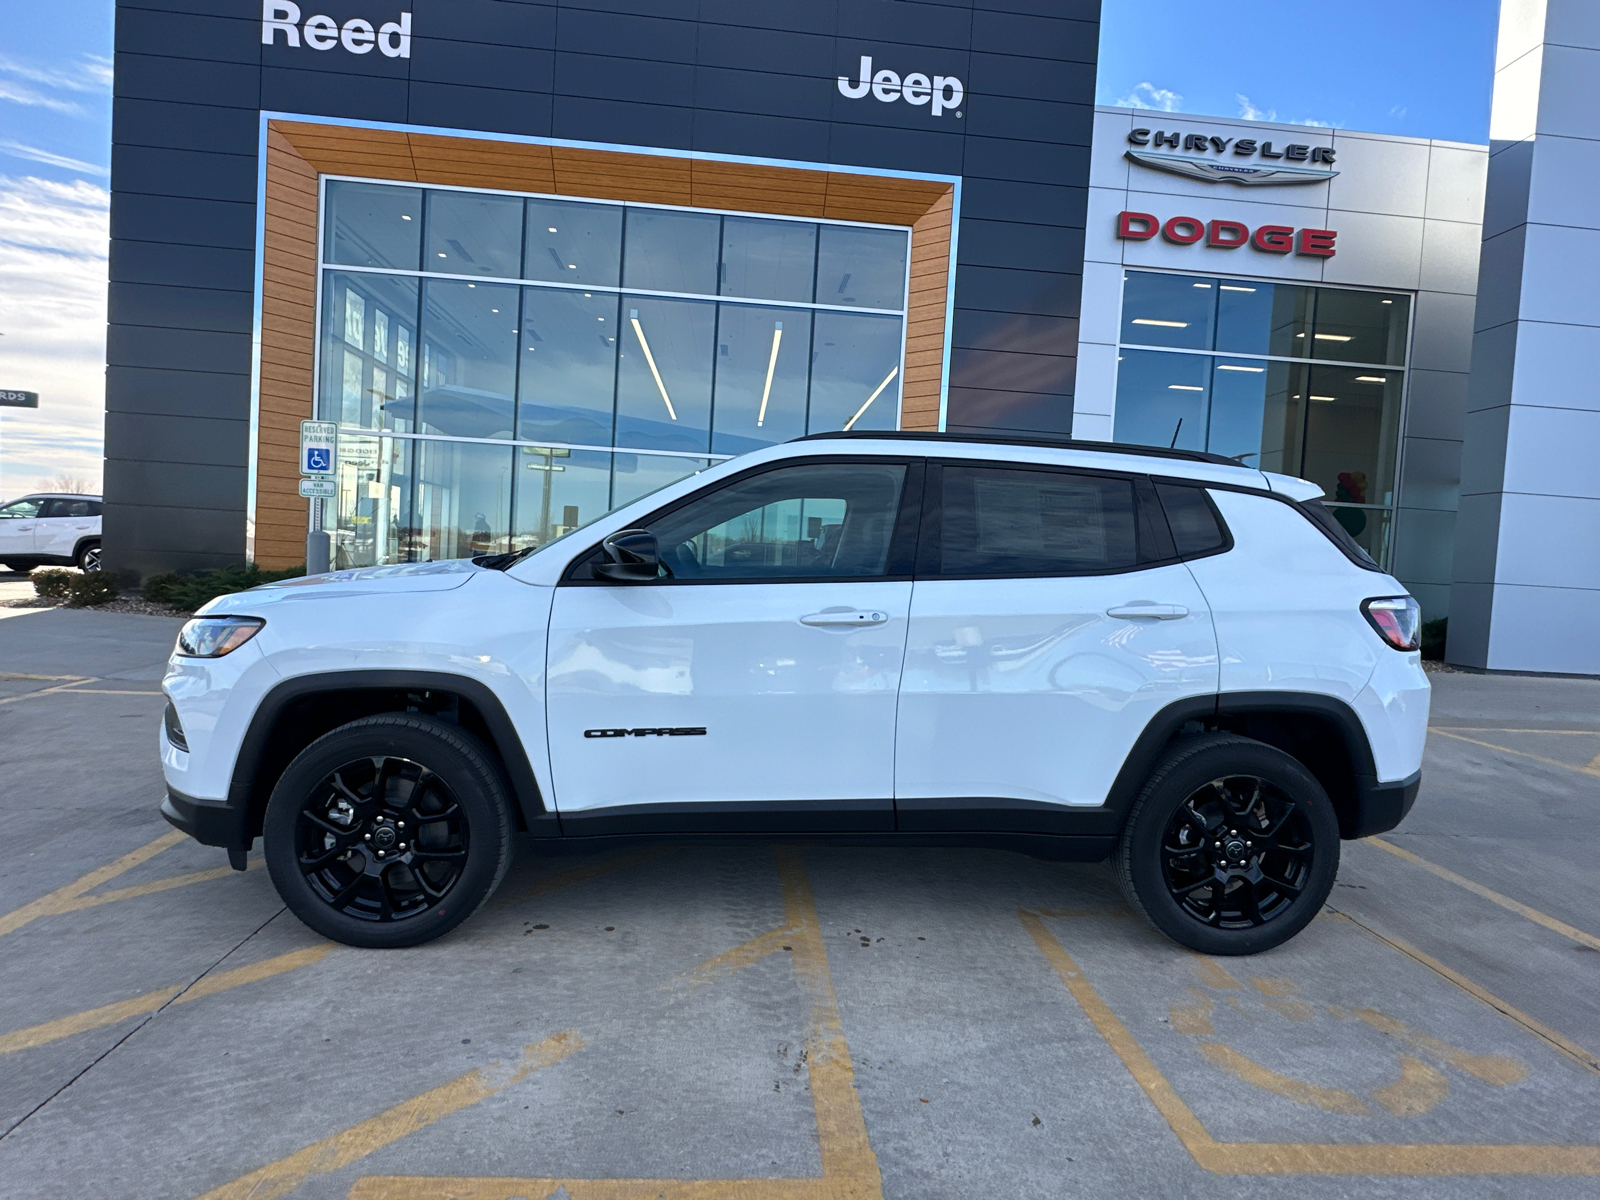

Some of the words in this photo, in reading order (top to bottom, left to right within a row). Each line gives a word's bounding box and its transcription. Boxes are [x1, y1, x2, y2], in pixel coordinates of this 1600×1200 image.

[262, 0, 412, 59] Reed
[837, 55, 964, 117] Jeep
[1128, 128, 1337, 163] CHRYSLER
[1212, 165, 1254, 174] CHRYSLER
[1116, 210, 1338, 258] DODGE
[304, 425, 334, 434] RESERVED
[304, 435, 334, 443] PARKING
[584, 727, 706, 738] COMPASS
